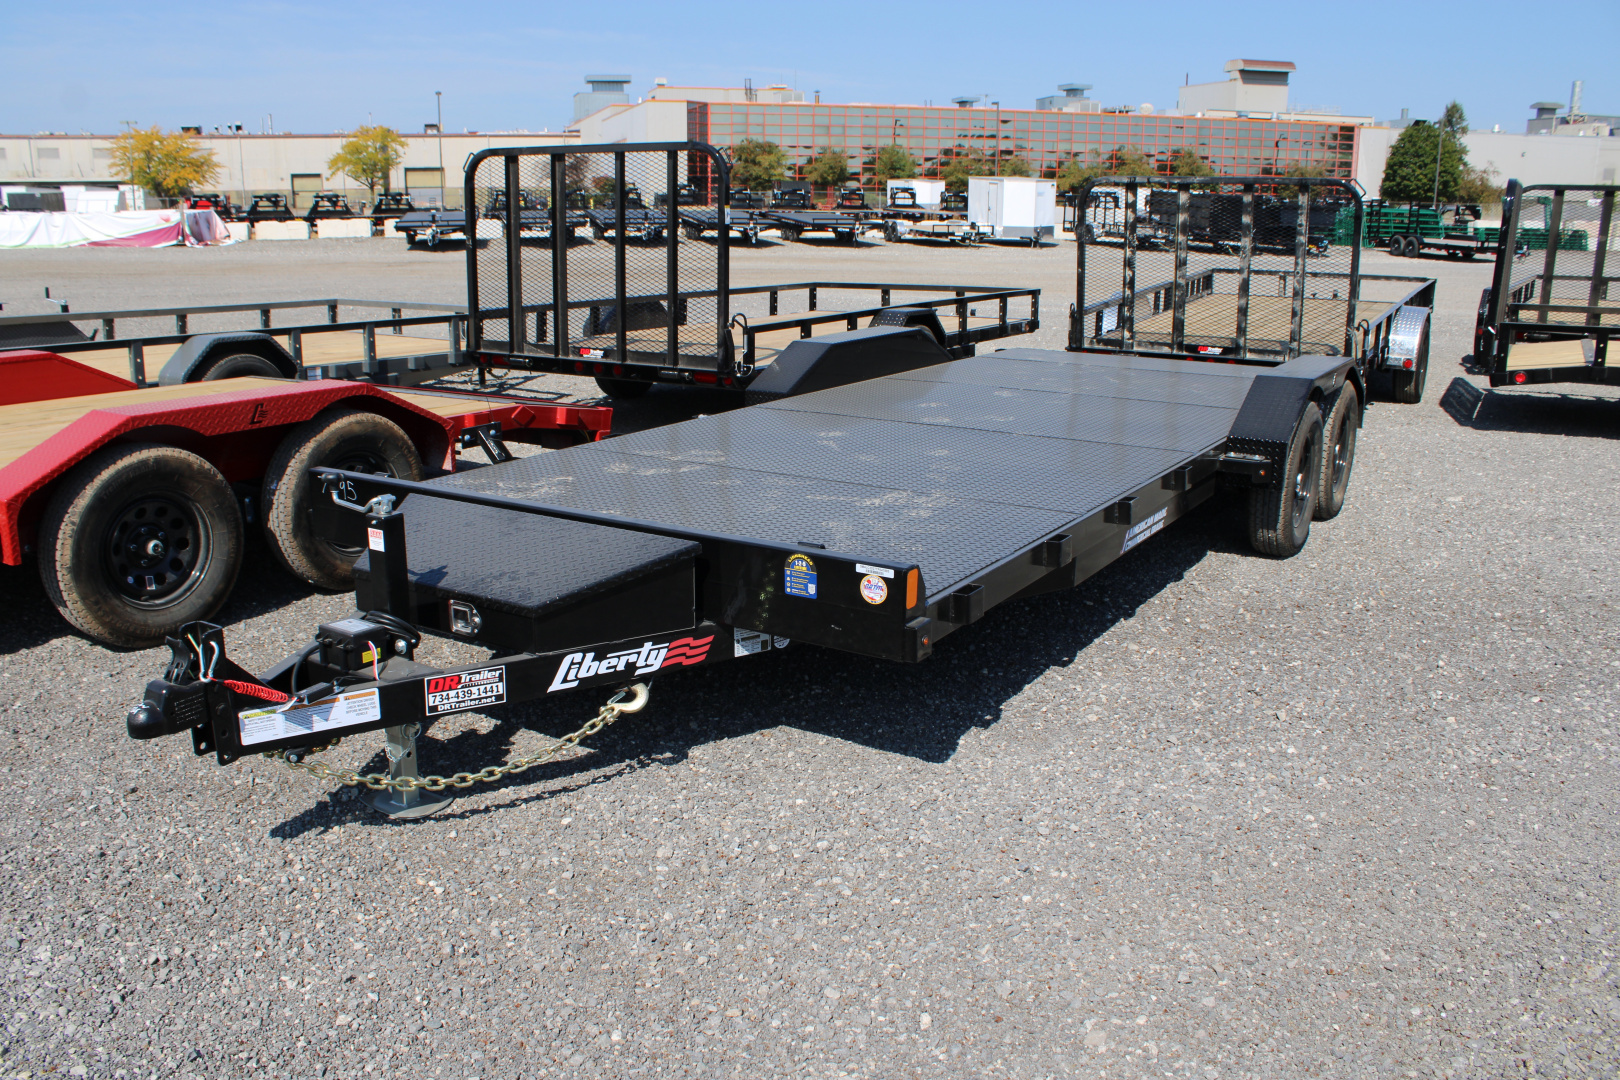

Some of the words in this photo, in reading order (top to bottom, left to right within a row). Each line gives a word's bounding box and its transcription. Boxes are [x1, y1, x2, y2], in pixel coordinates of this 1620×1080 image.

[546, 641, 669, 693] Liberty
[428, 676, 460, 694] DR
[460, 670, 502, 684] Trailer
[431, 684, 501, 705] 734-439-1441
[437, 695, 496, 711] DRTrailer.net
